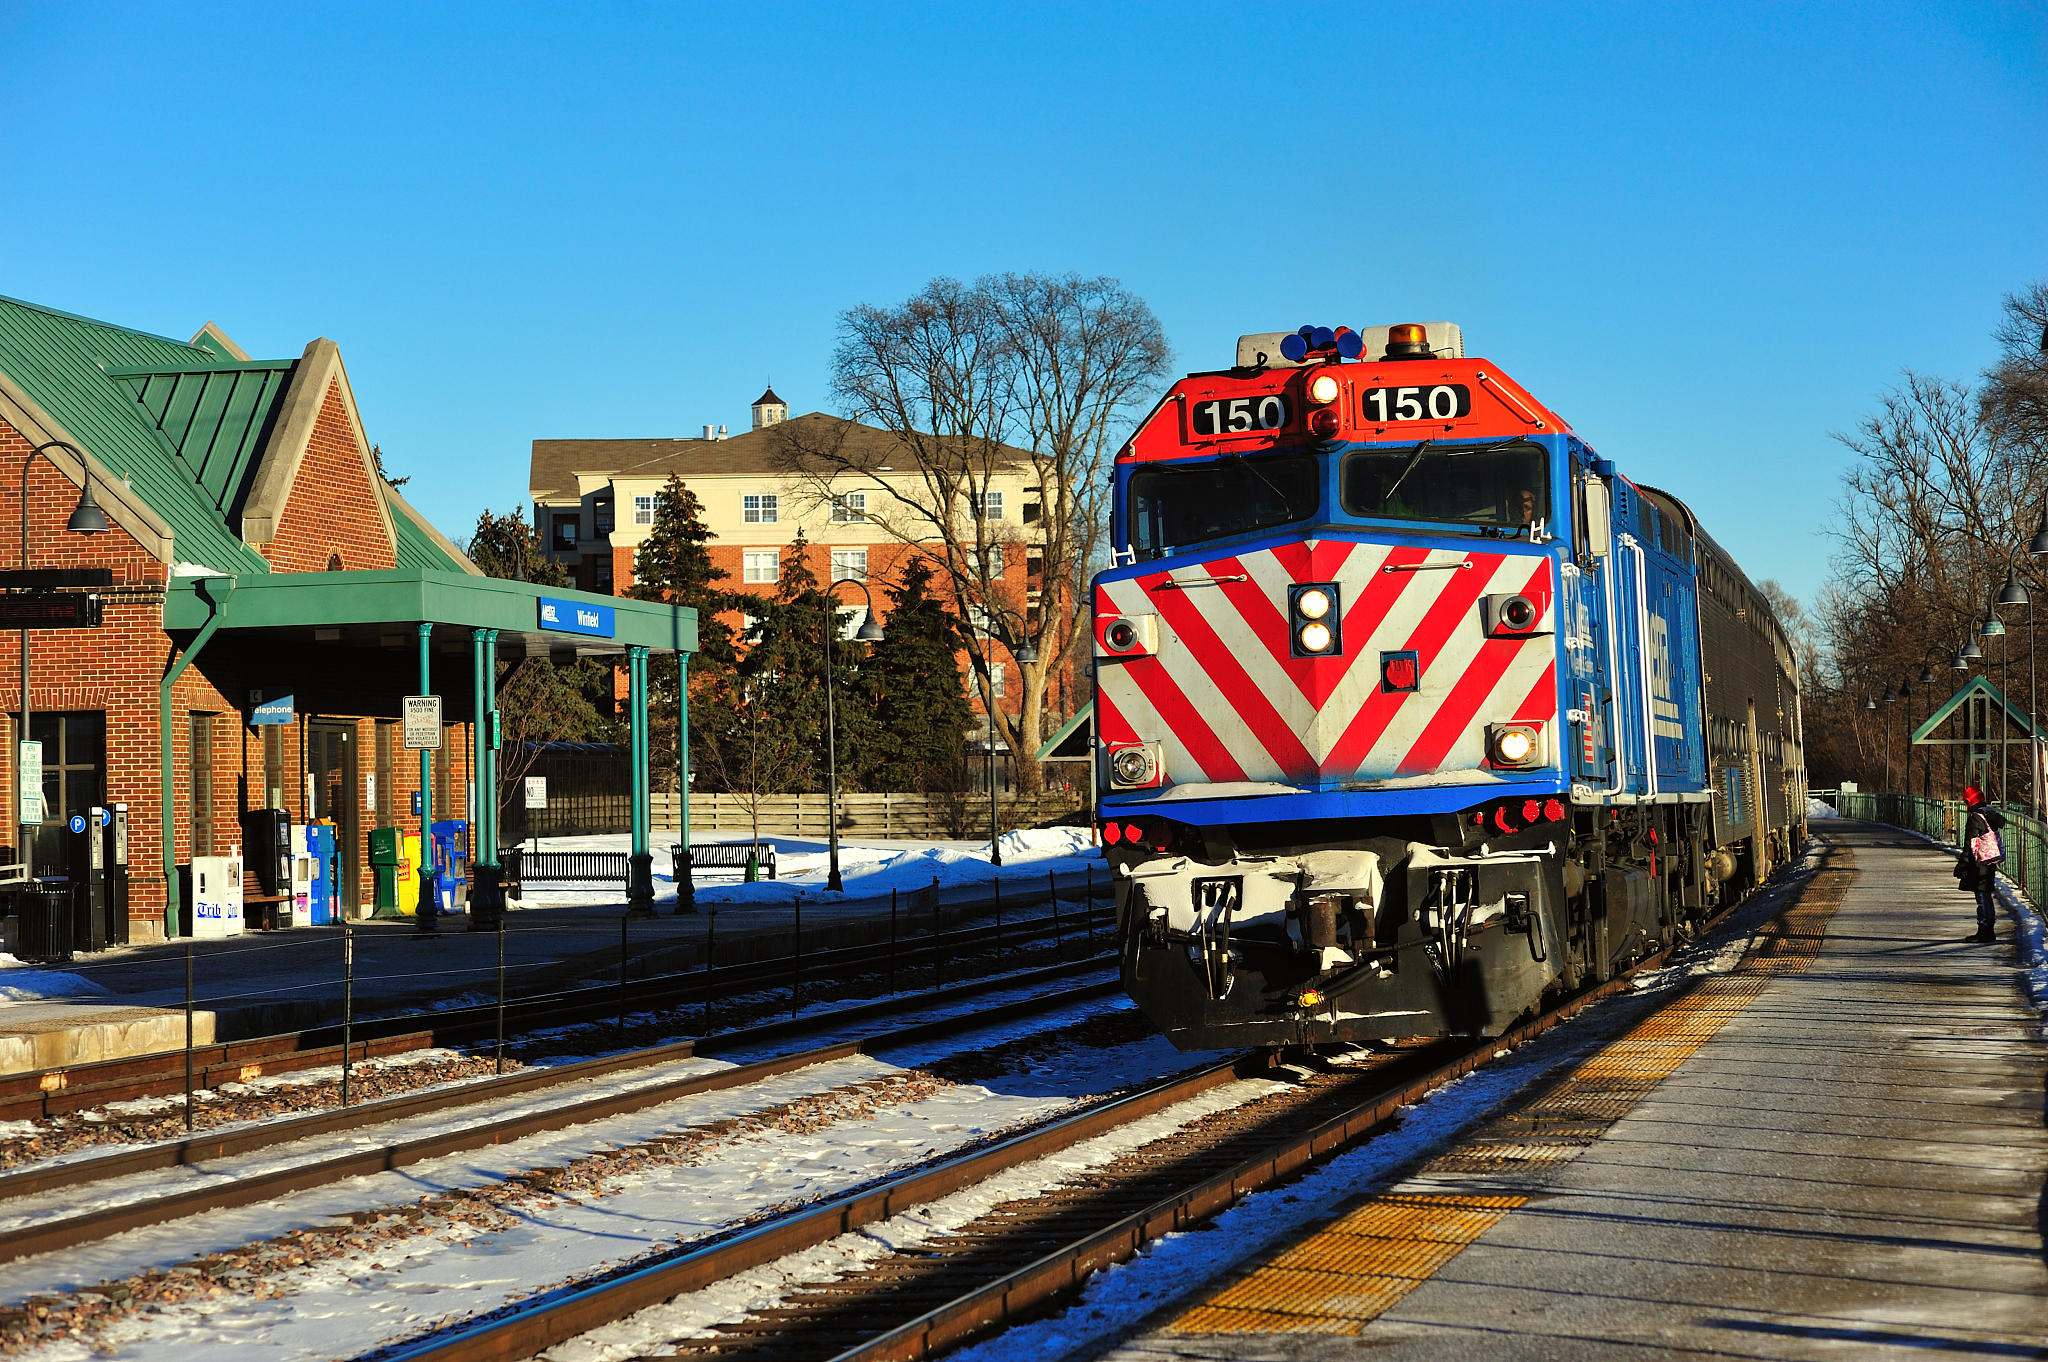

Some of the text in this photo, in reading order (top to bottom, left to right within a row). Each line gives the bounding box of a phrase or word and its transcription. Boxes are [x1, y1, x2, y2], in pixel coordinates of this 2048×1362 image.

[1204, 396, 1285, 434] 150
[1369, 385, 1458, 422] 150
[577, 609, 599, 629] Winfield
[197, 902, 221, 917] Trib
